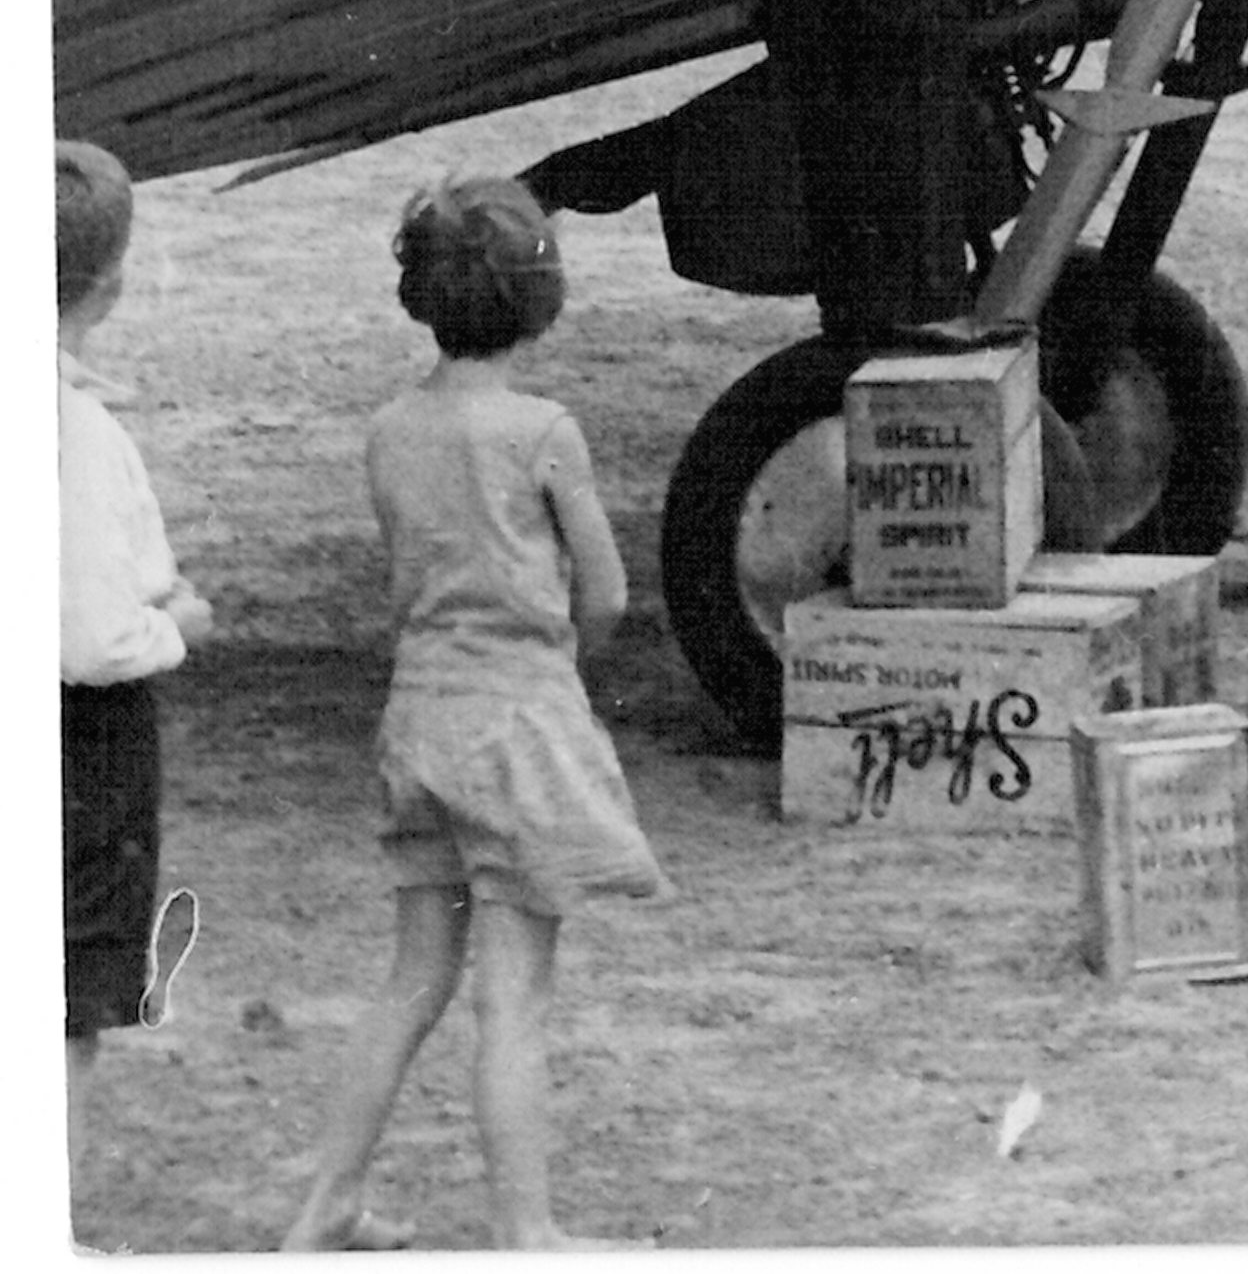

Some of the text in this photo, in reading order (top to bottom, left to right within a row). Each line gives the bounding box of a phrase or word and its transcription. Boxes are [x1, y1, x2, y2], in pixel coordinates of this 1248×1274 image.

[873, 423, 974, 452] SHELL
[857, 461, 988, 511] IMPERIAL
[878, 522, 972, 549] SPIRIT
[792, 658, 963, 691] MOTOR SPIRIT
[832, 688, 1040, 828] Shell
